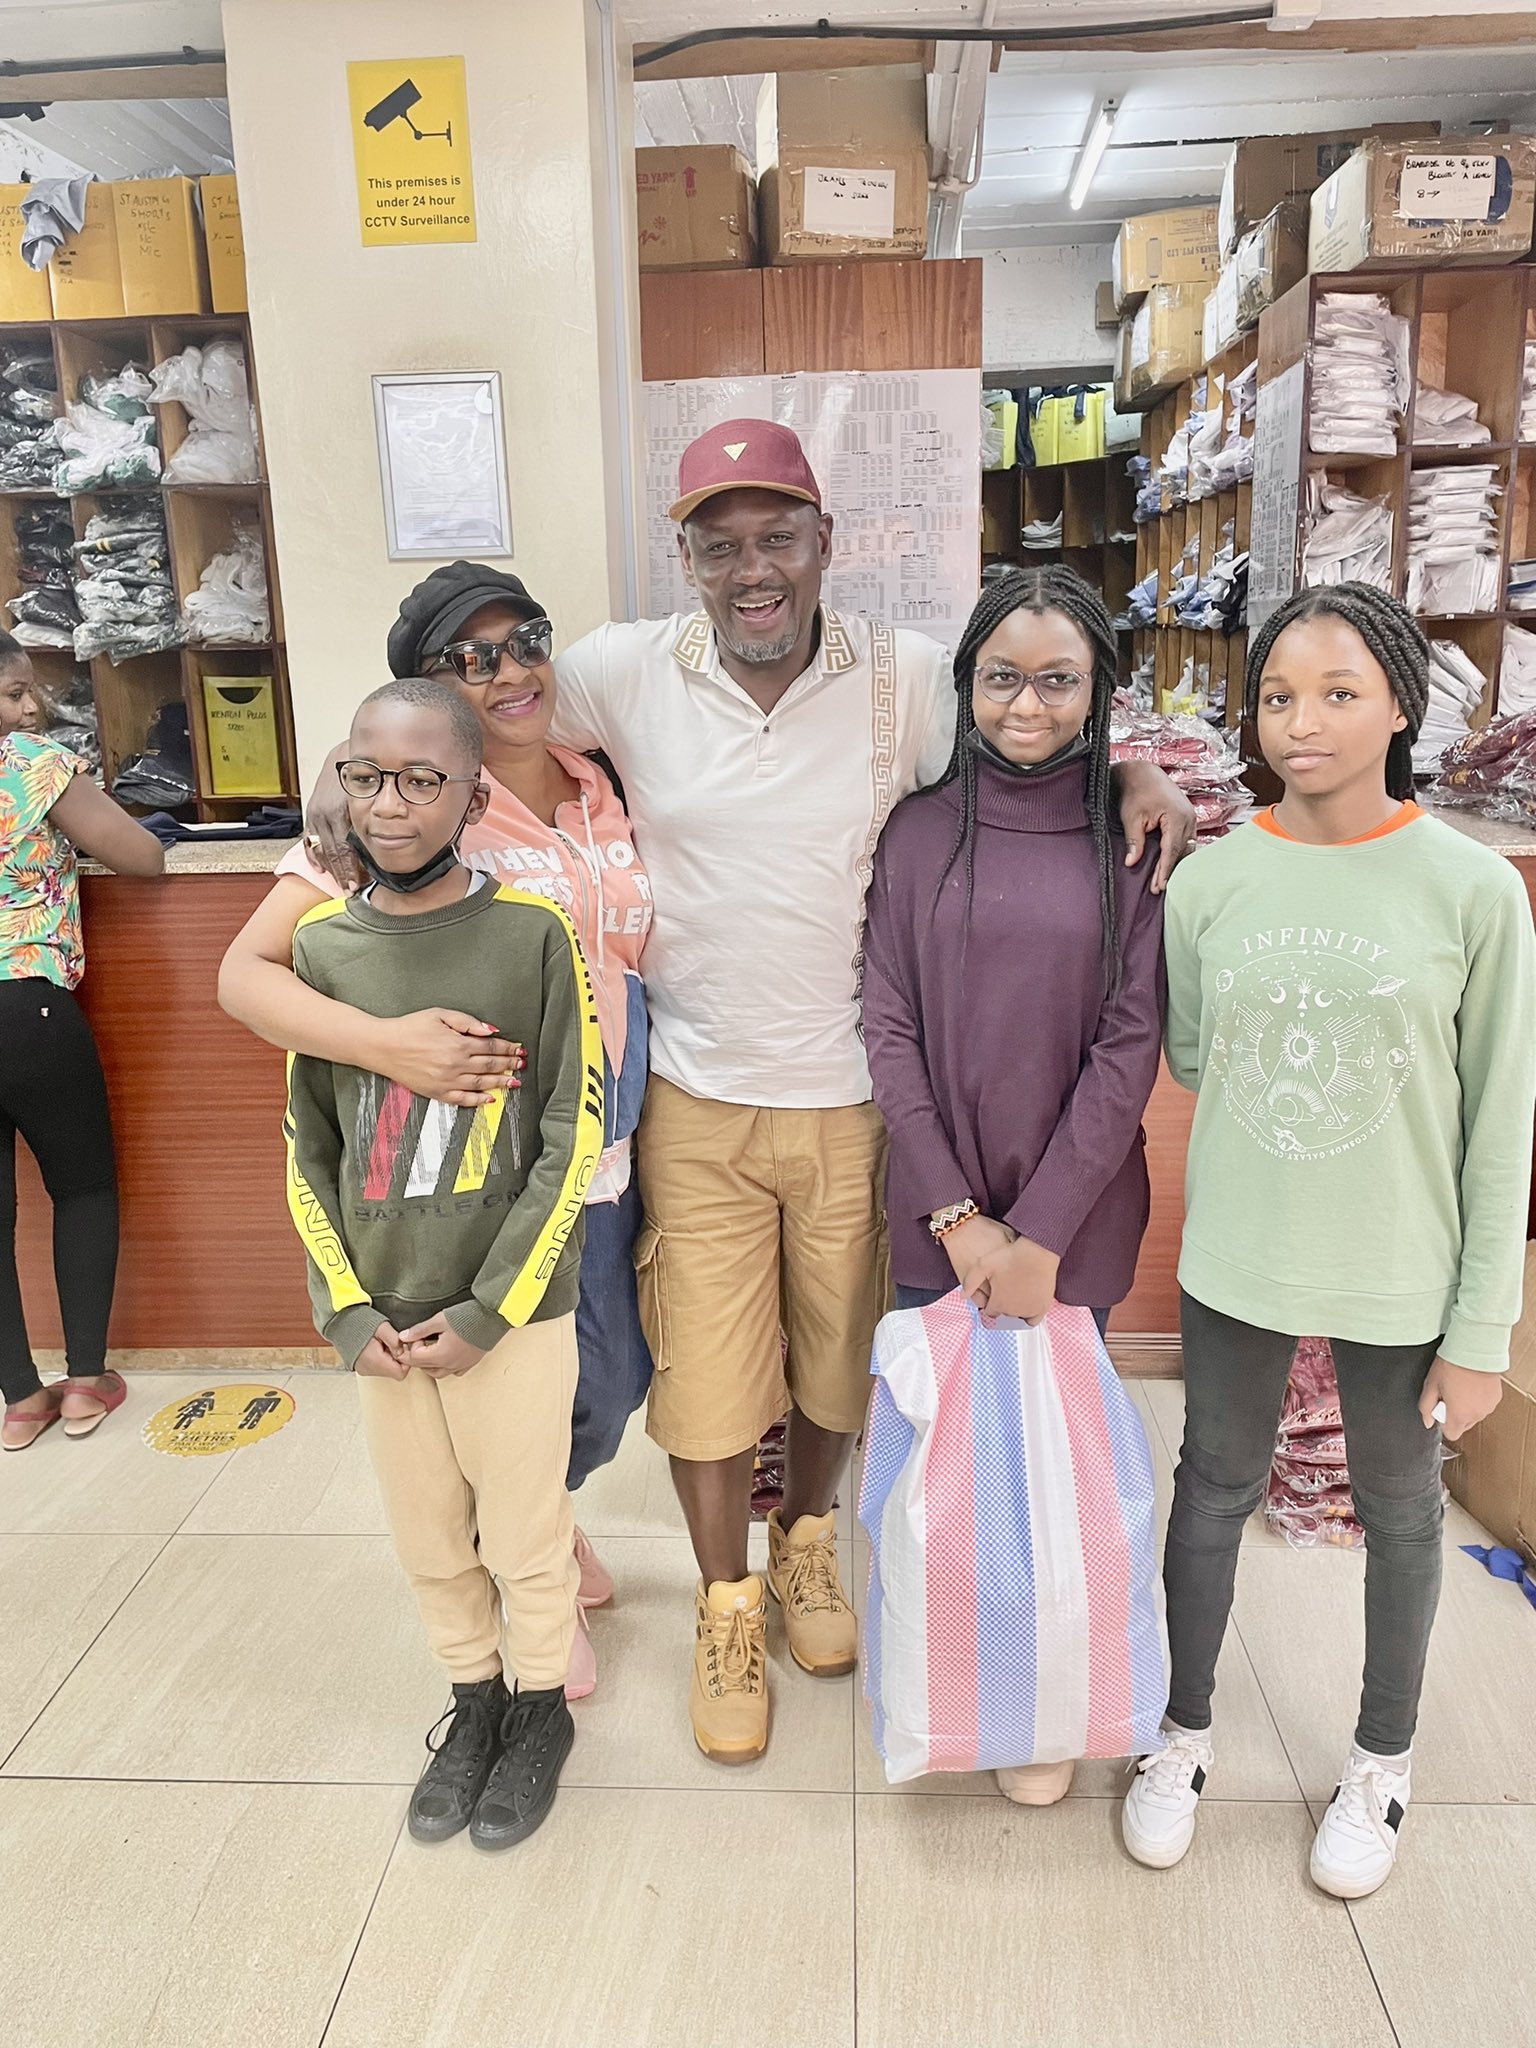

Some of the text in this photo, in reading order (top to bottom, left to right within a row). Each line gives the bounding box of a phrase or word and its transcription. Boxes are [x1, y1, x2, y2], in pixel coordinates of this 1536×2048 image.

[367, 174, 461, 190] This premises is
[376, 194, 456, 208] under 24 hour
[364, 213, 471, 228] CCTV Surveillance
[1241, 927, 1391, 963] INFINITY
